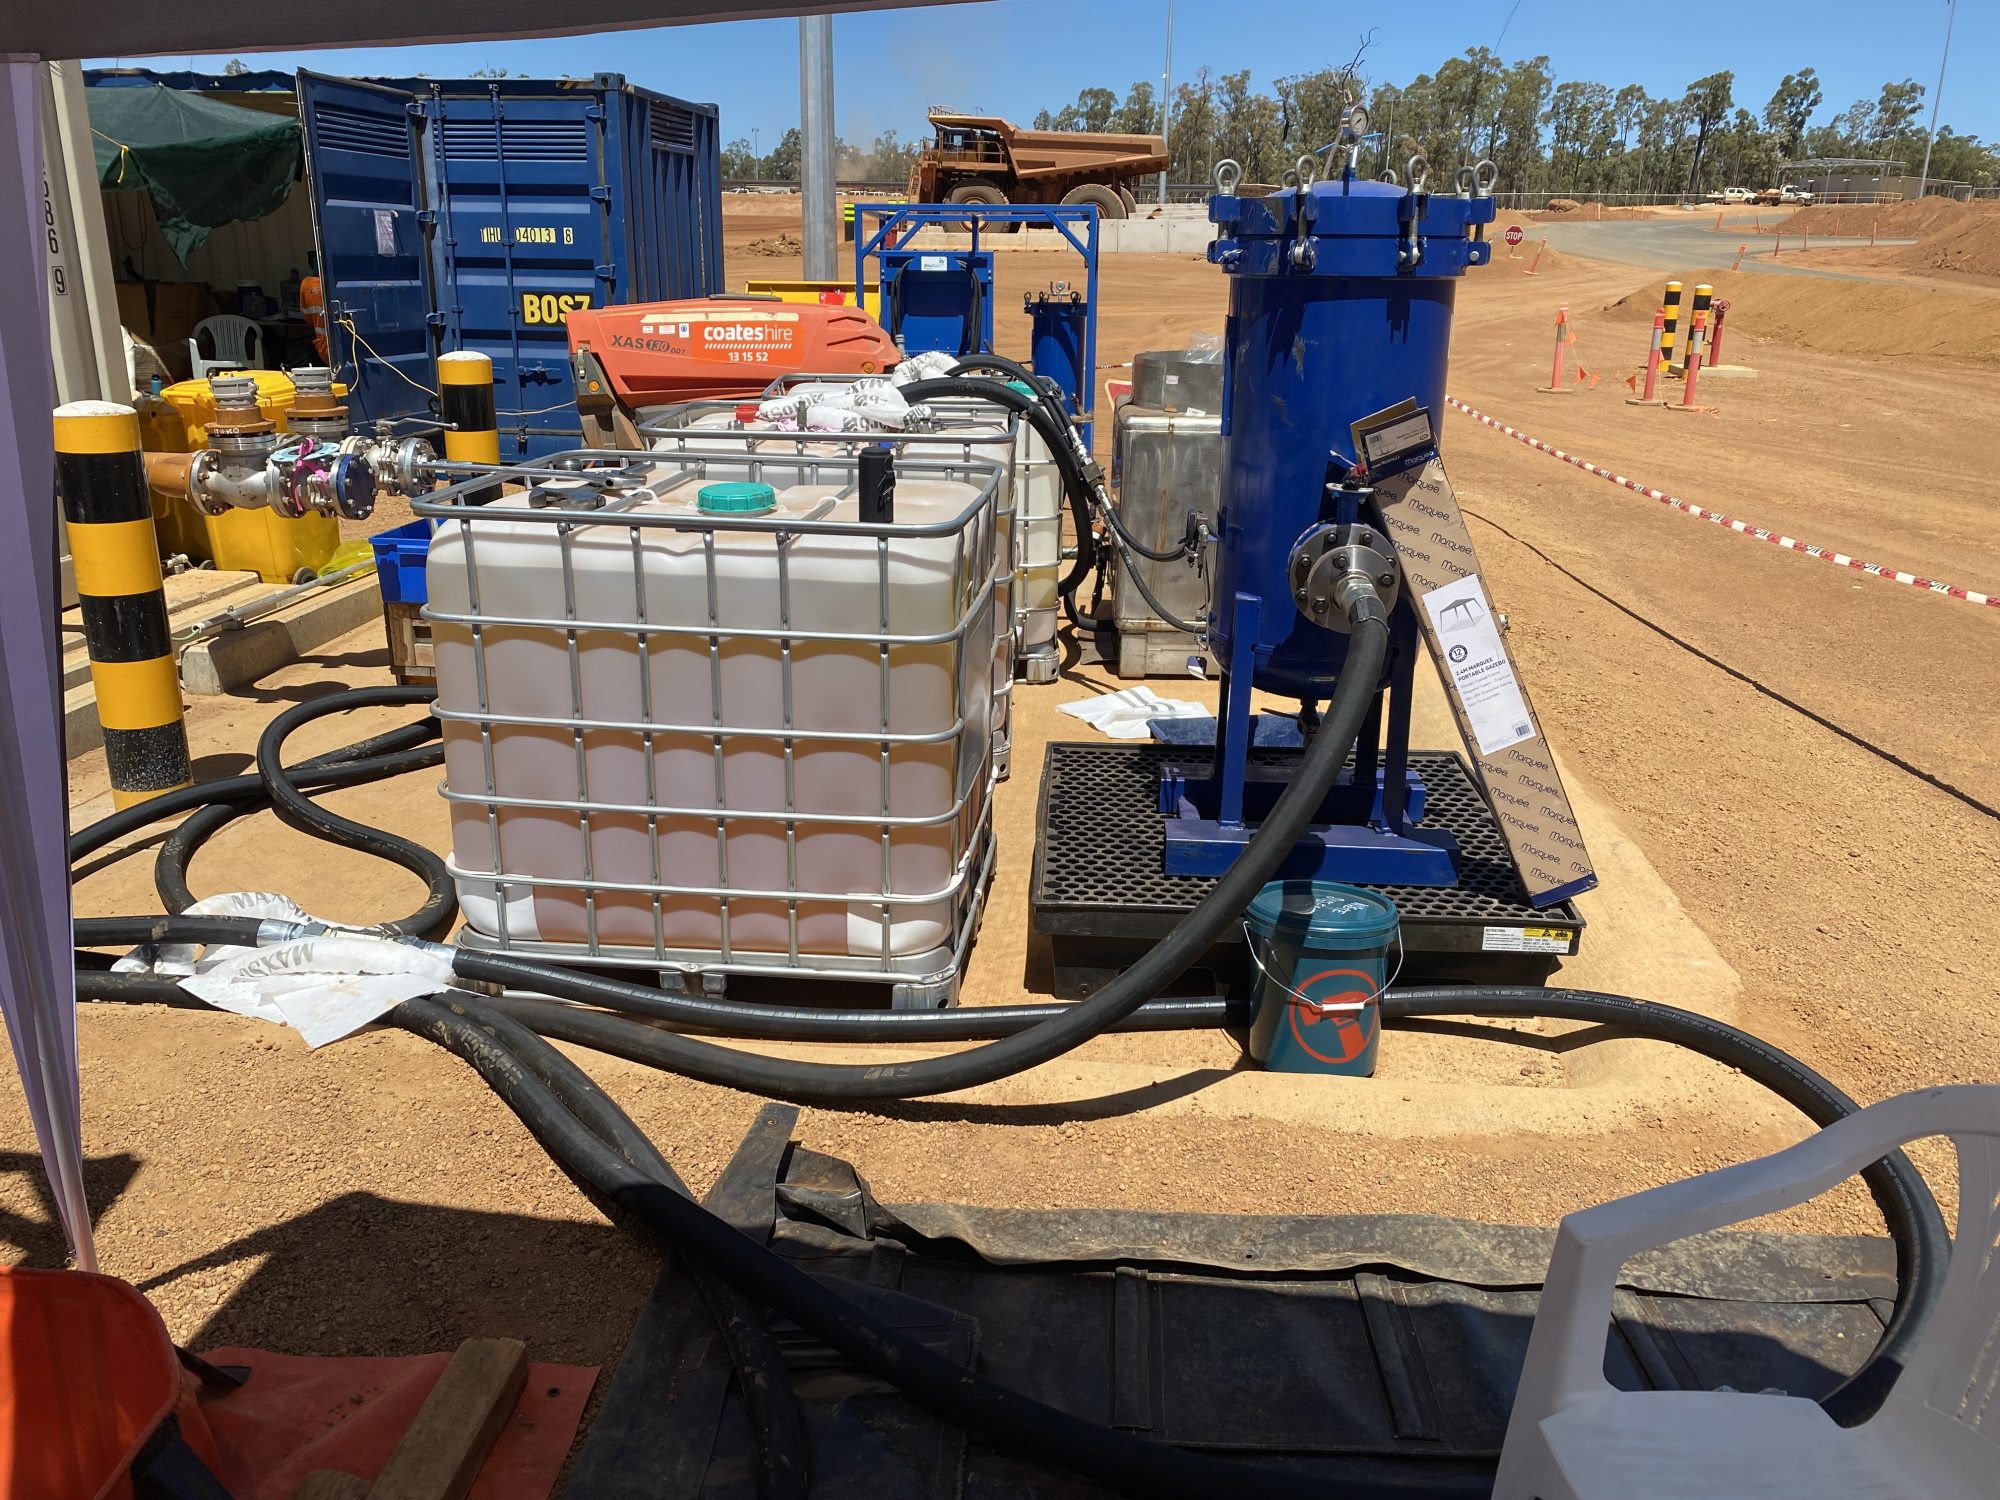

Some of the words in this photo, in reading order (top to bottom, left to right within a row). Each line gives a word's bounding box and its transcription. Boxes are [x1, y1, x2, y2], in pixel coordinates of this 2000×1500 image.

[564, 227, 573, 244] 8
[1505, 231, 1523, 240] STOP
[54, 267, 66, 294] 9
[611, 335, 645, 349] XAS
[646, 340, 671, 352] 130
[728, 352, 740, 362] 13
[742, 352, 753, 362] 15
[755, 352, 769, 362] 52
[1373, 486, 1399, 500] quee
[1453, 648, 1462, 657] 12
[1458, 668, 1485, 682] PORTABLE
[1485, 659, 1506, 671] GAZEBO
[1468, 657, 1494, 671] MARQUEE
